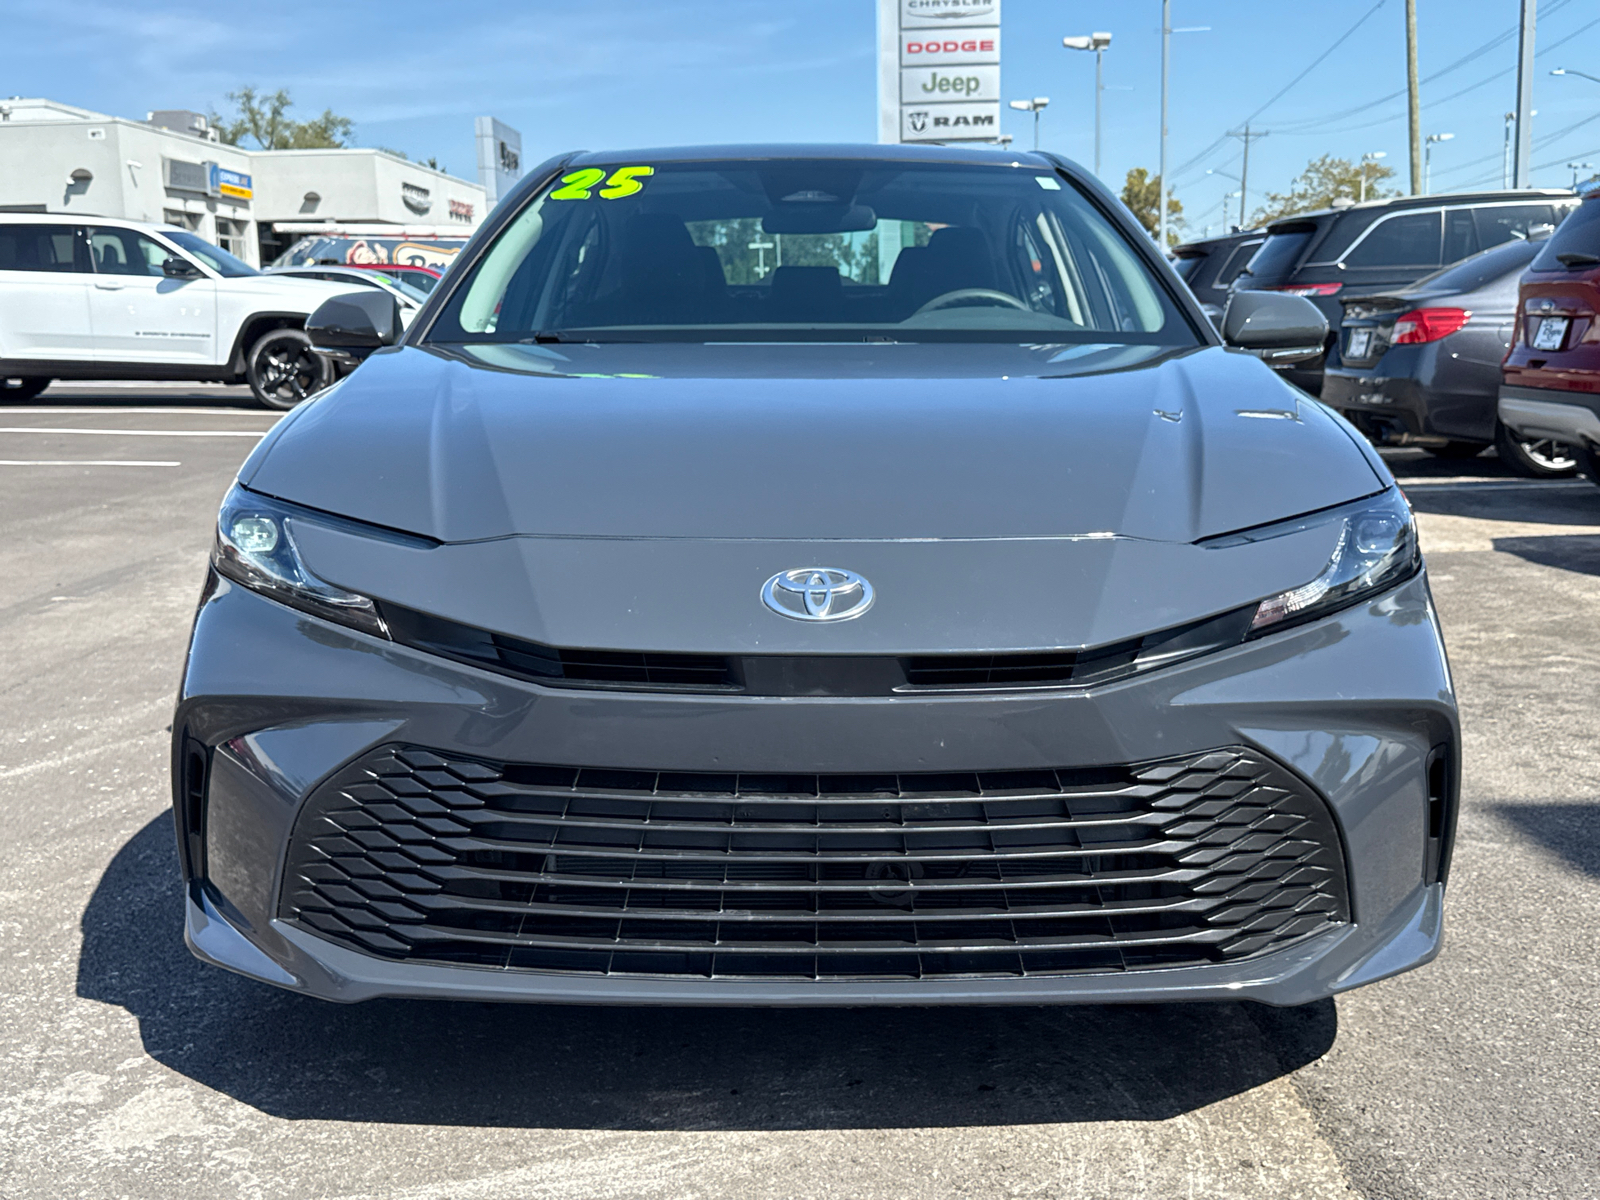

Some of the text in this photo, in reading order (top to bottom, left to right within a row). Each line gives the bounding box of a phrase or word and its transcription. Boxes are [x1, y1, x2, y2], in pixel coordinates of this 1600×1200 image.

[908, 0, 992, 8] CHRYSLER
[907, 40, 995, 54] DODGE
[922, 72, 980, 96] Jeep
[933, 115, 994, 127] RAM
[549, 166, 655, 200] 25
